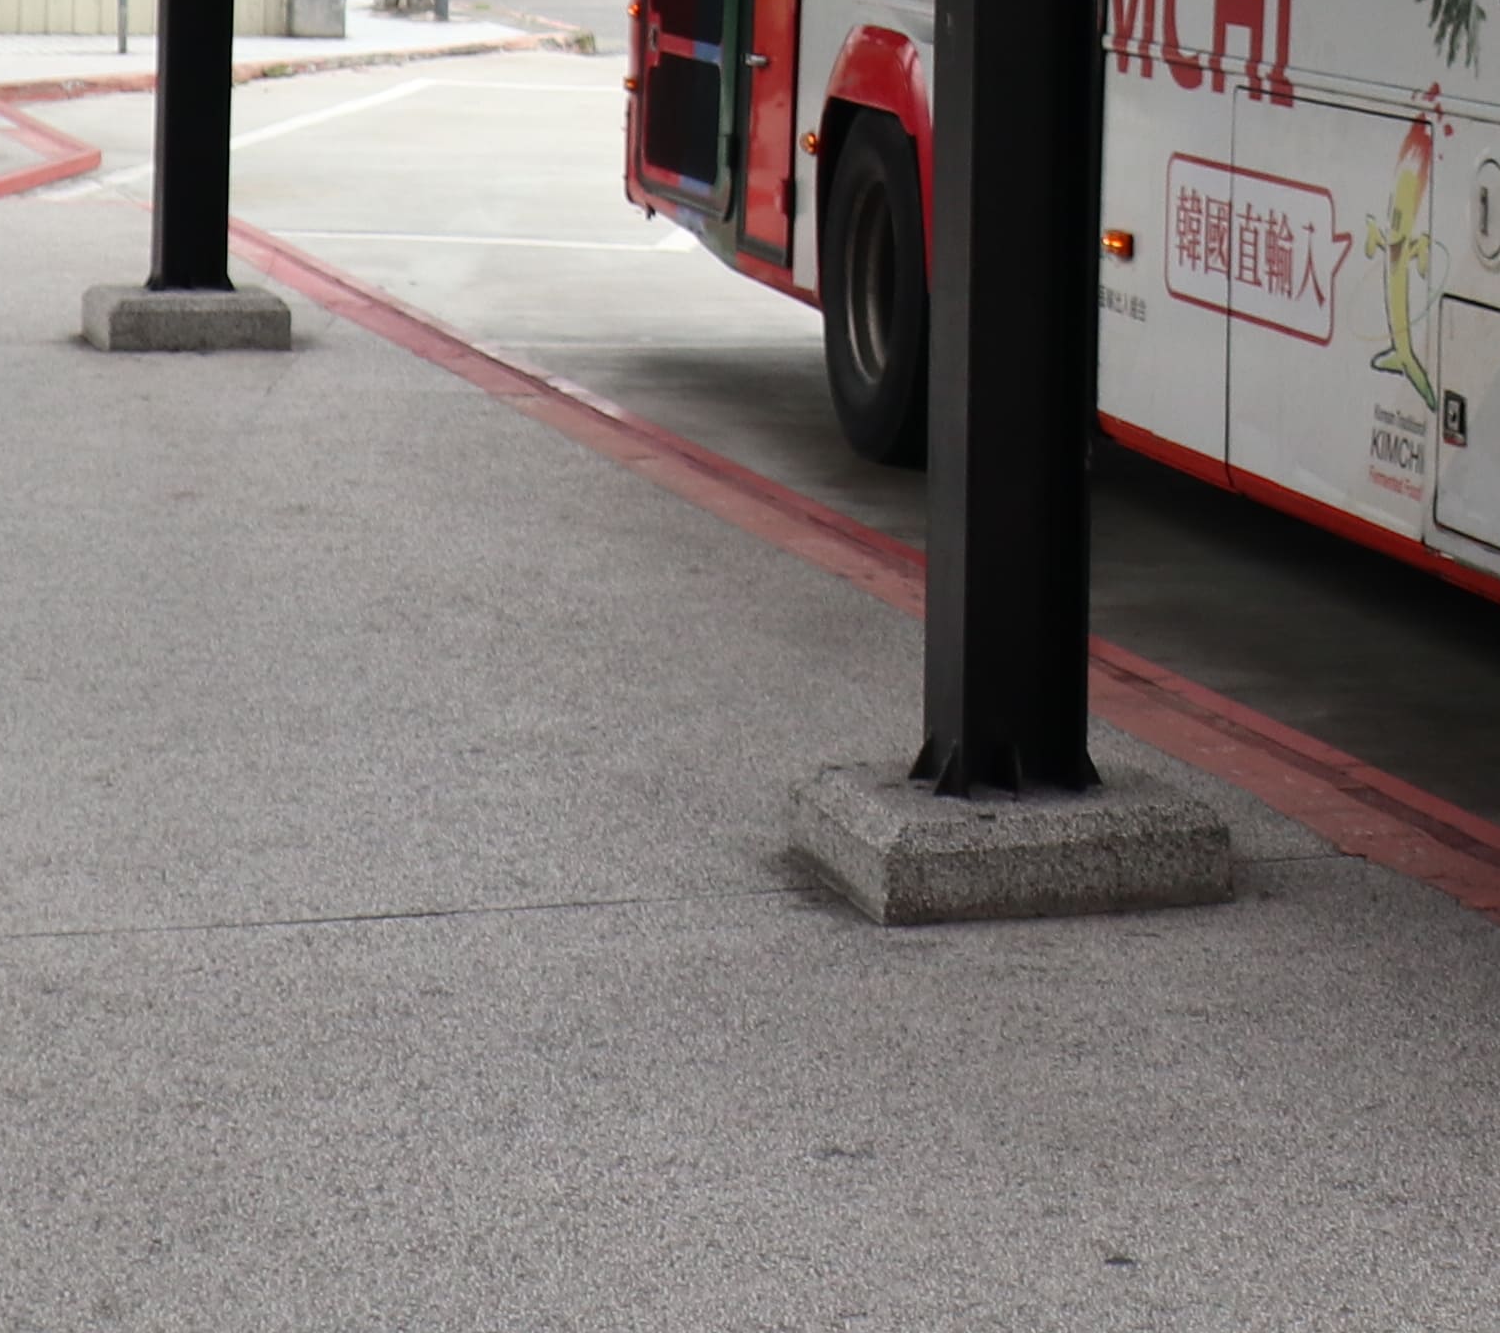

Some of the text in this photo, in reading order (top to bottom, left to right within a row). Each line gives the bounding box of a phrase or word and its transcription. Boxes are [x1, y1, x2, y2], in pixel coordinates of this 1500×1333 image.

[1175, 186, 1325, 310] 韓國直輸入
[1370, 428, 1425, 475] KIMCHI
